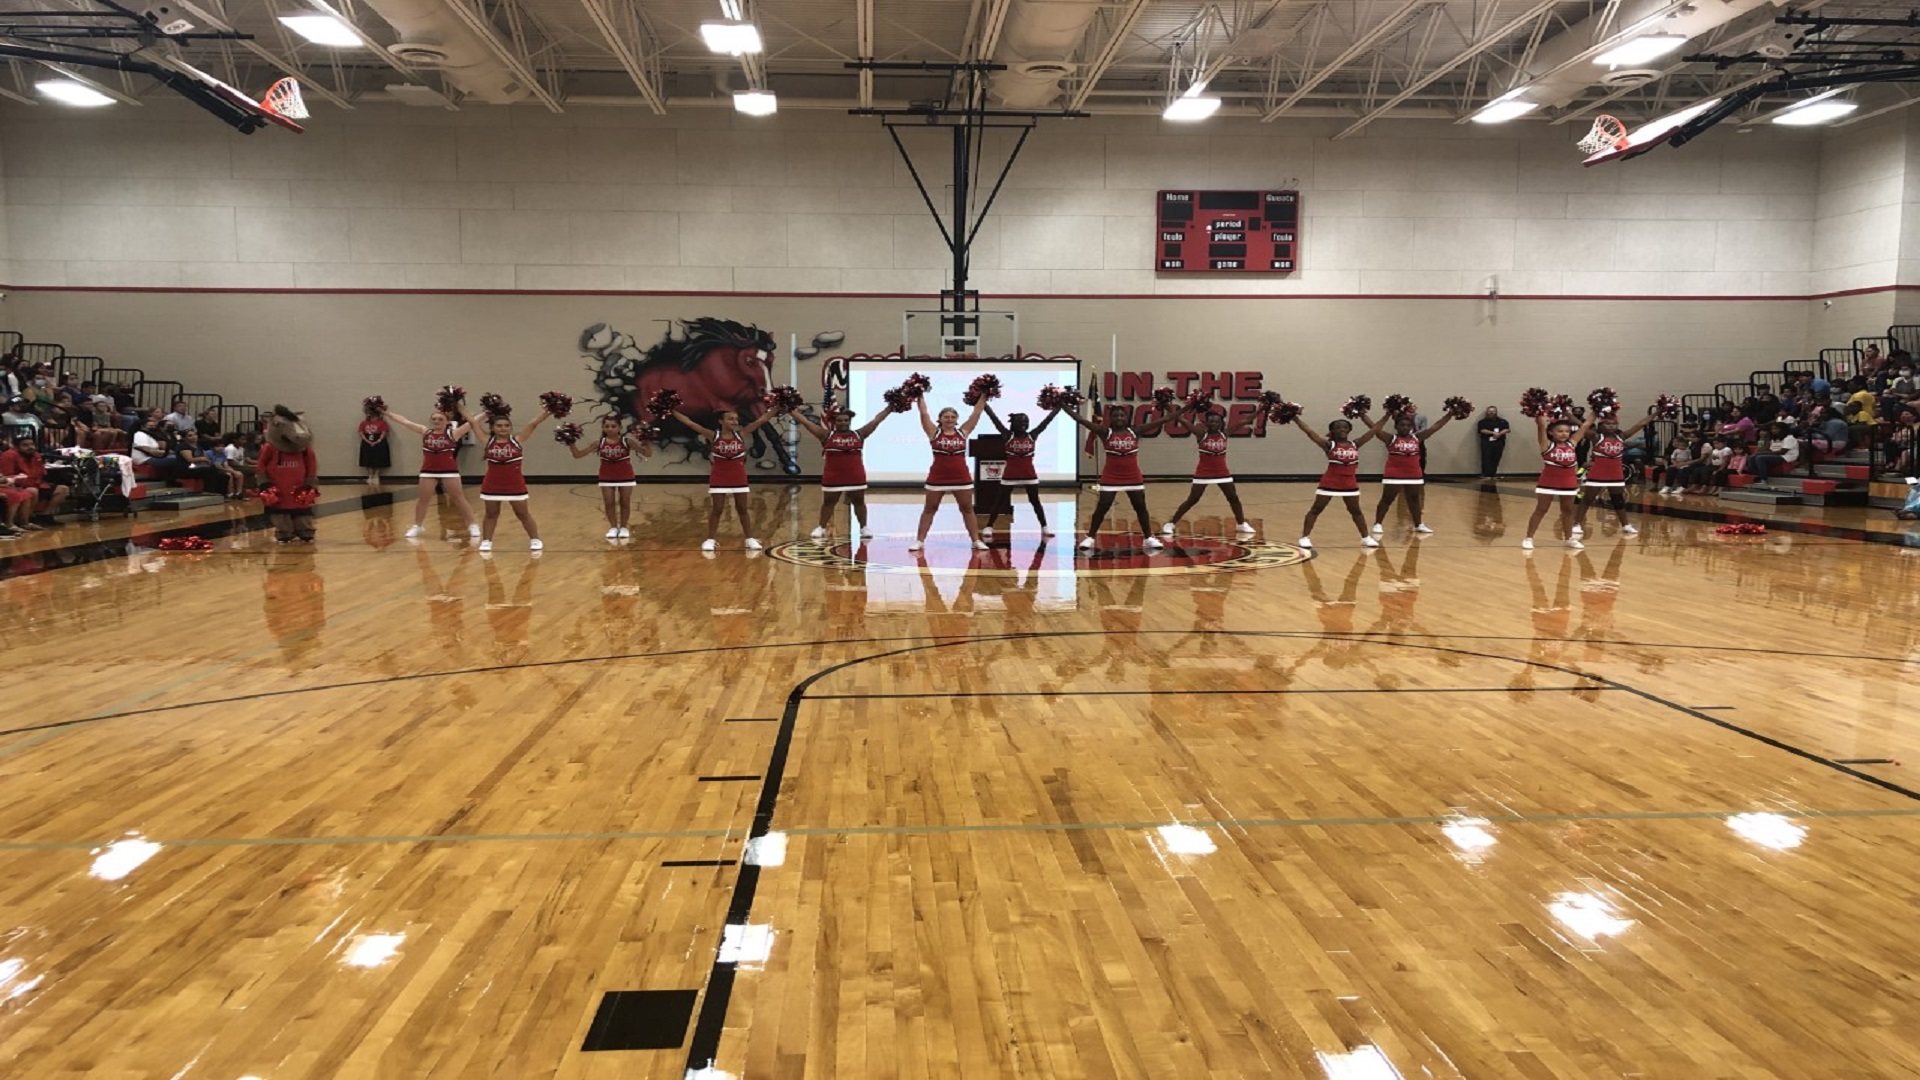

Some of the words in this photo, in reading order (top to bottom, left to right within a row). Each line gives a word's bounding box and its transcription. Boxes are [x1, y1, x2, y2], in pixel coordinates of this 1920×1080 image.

[1166, 193, 1189, 201] Home
[1215, 220, 1242, 229] period
[1214, 233, 1242, 242] player
[1216, 261, 1239, 270] game
[1103, 371, 1153, 400] IN
[1167, 371, 1263, 400] THE
[1103, 403, 1266, 437] HOUE!
